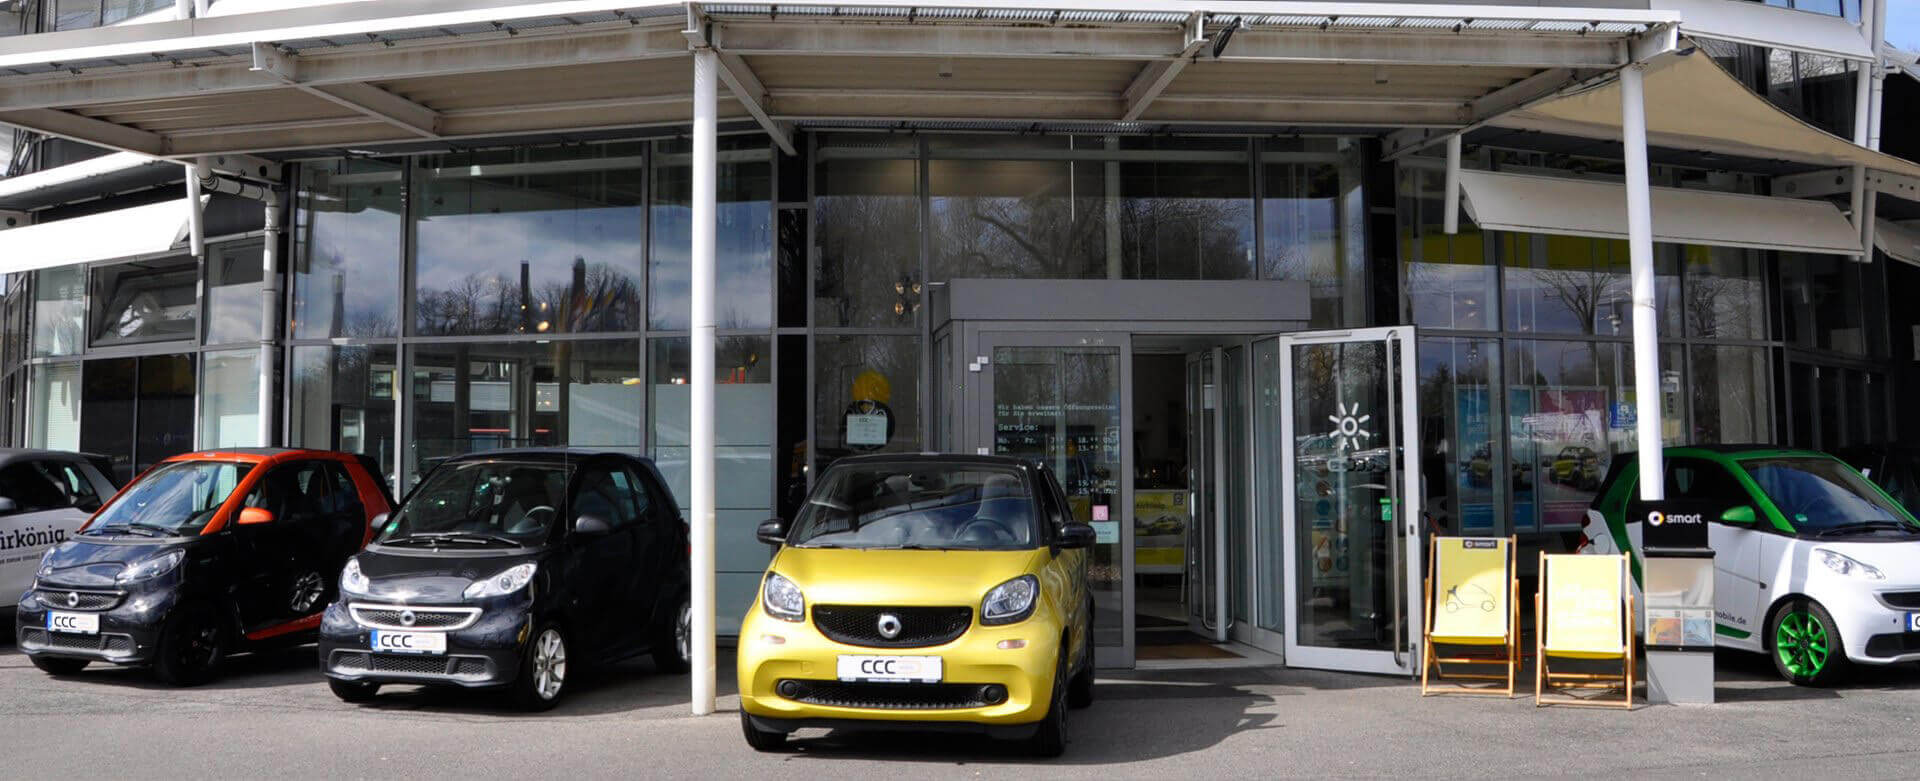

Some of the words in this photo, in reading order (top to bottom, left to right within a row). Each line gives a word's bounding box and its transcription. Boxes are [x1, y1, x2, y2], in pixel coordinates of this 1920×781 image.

[1666, 513, 1702, 523] smart
[54, 615, 77, 629] CCC
[381, 634, 413, 648] CCC
[861, 659, 897, 674] CCC
